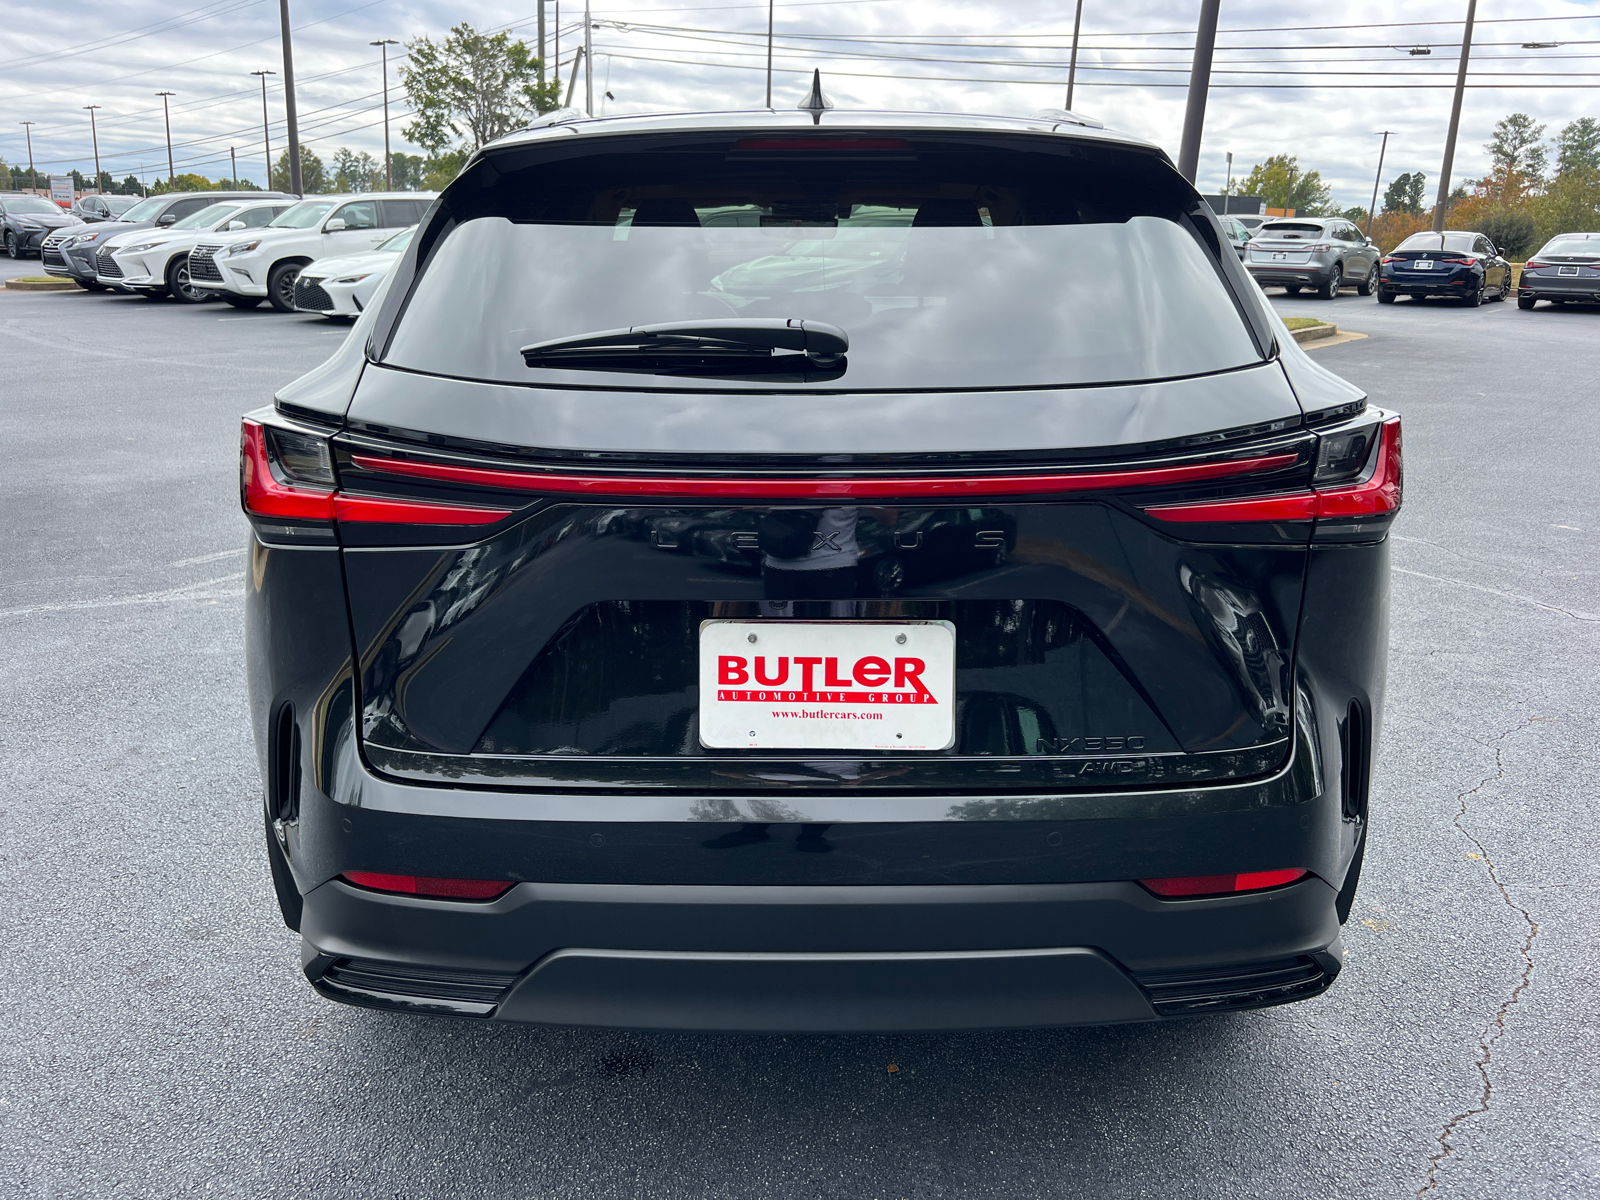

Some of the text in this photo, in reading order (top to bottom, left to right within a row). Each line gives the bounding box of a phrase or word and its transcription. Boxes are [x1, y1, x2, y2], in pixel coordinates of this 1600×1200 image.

[650, 530, 1005, 551] LEXUS
[719, 691, 931, 703] AUTOMOTIVE GROUP
[771, 709, 883, 720] www.butlercars.com
[1078, 761, 1134, 774] AWD
